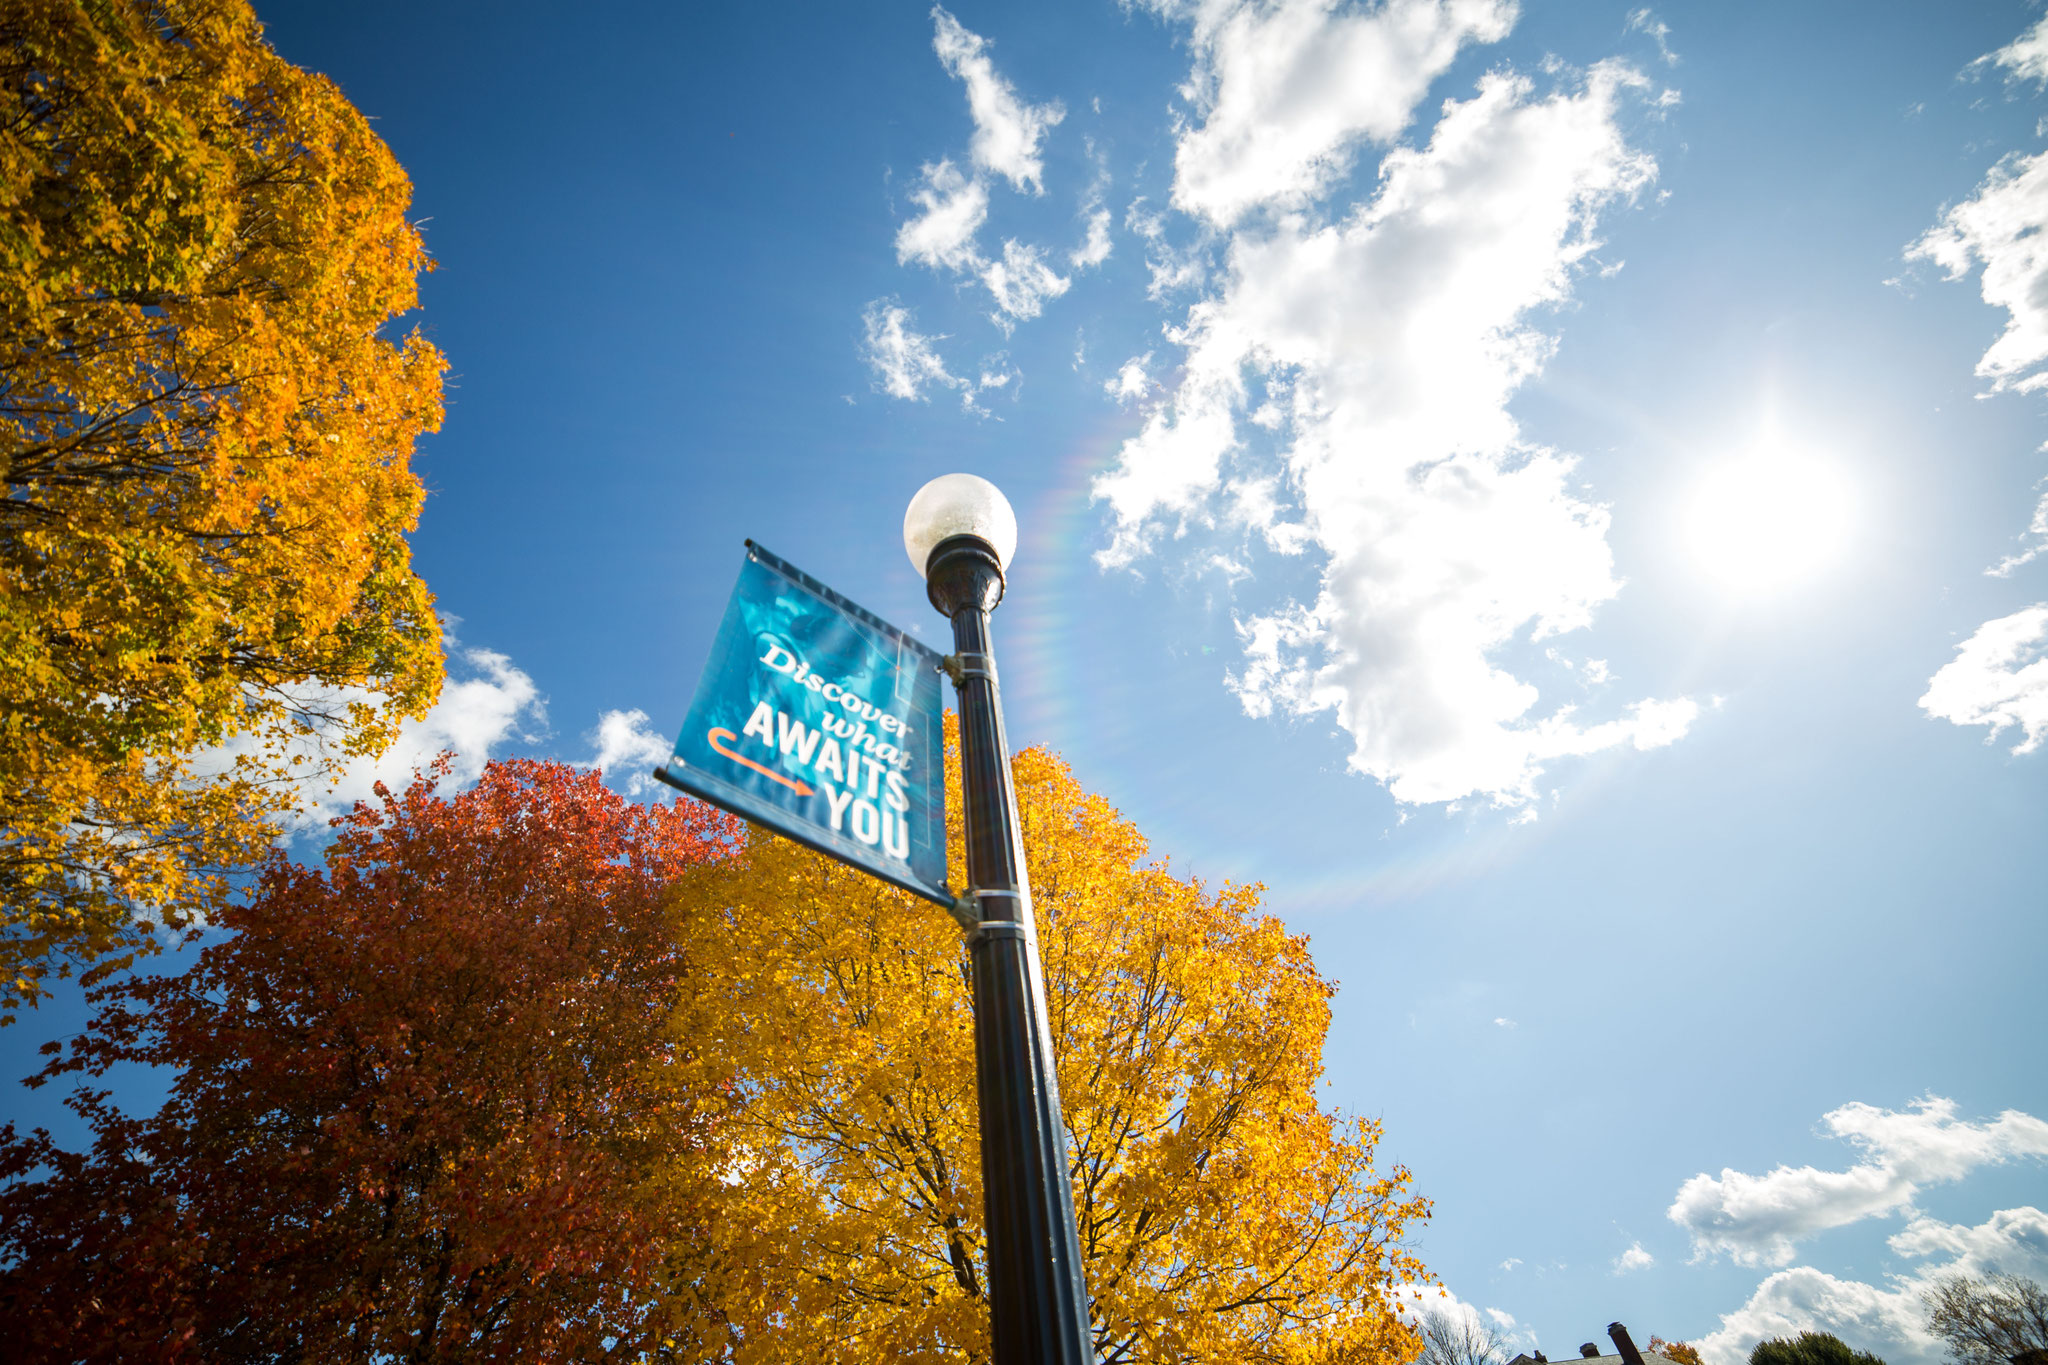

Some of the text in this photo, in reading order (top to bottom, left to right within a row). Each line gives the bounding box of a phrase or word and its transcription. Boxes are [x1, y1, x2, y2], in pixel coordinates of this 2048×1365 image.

[759, 643, 913, 738] Discover
[743, 700, 910, 813] AWAITS
[821, 710, 911, 771] what
[823, 782, 910, 860] YOU
